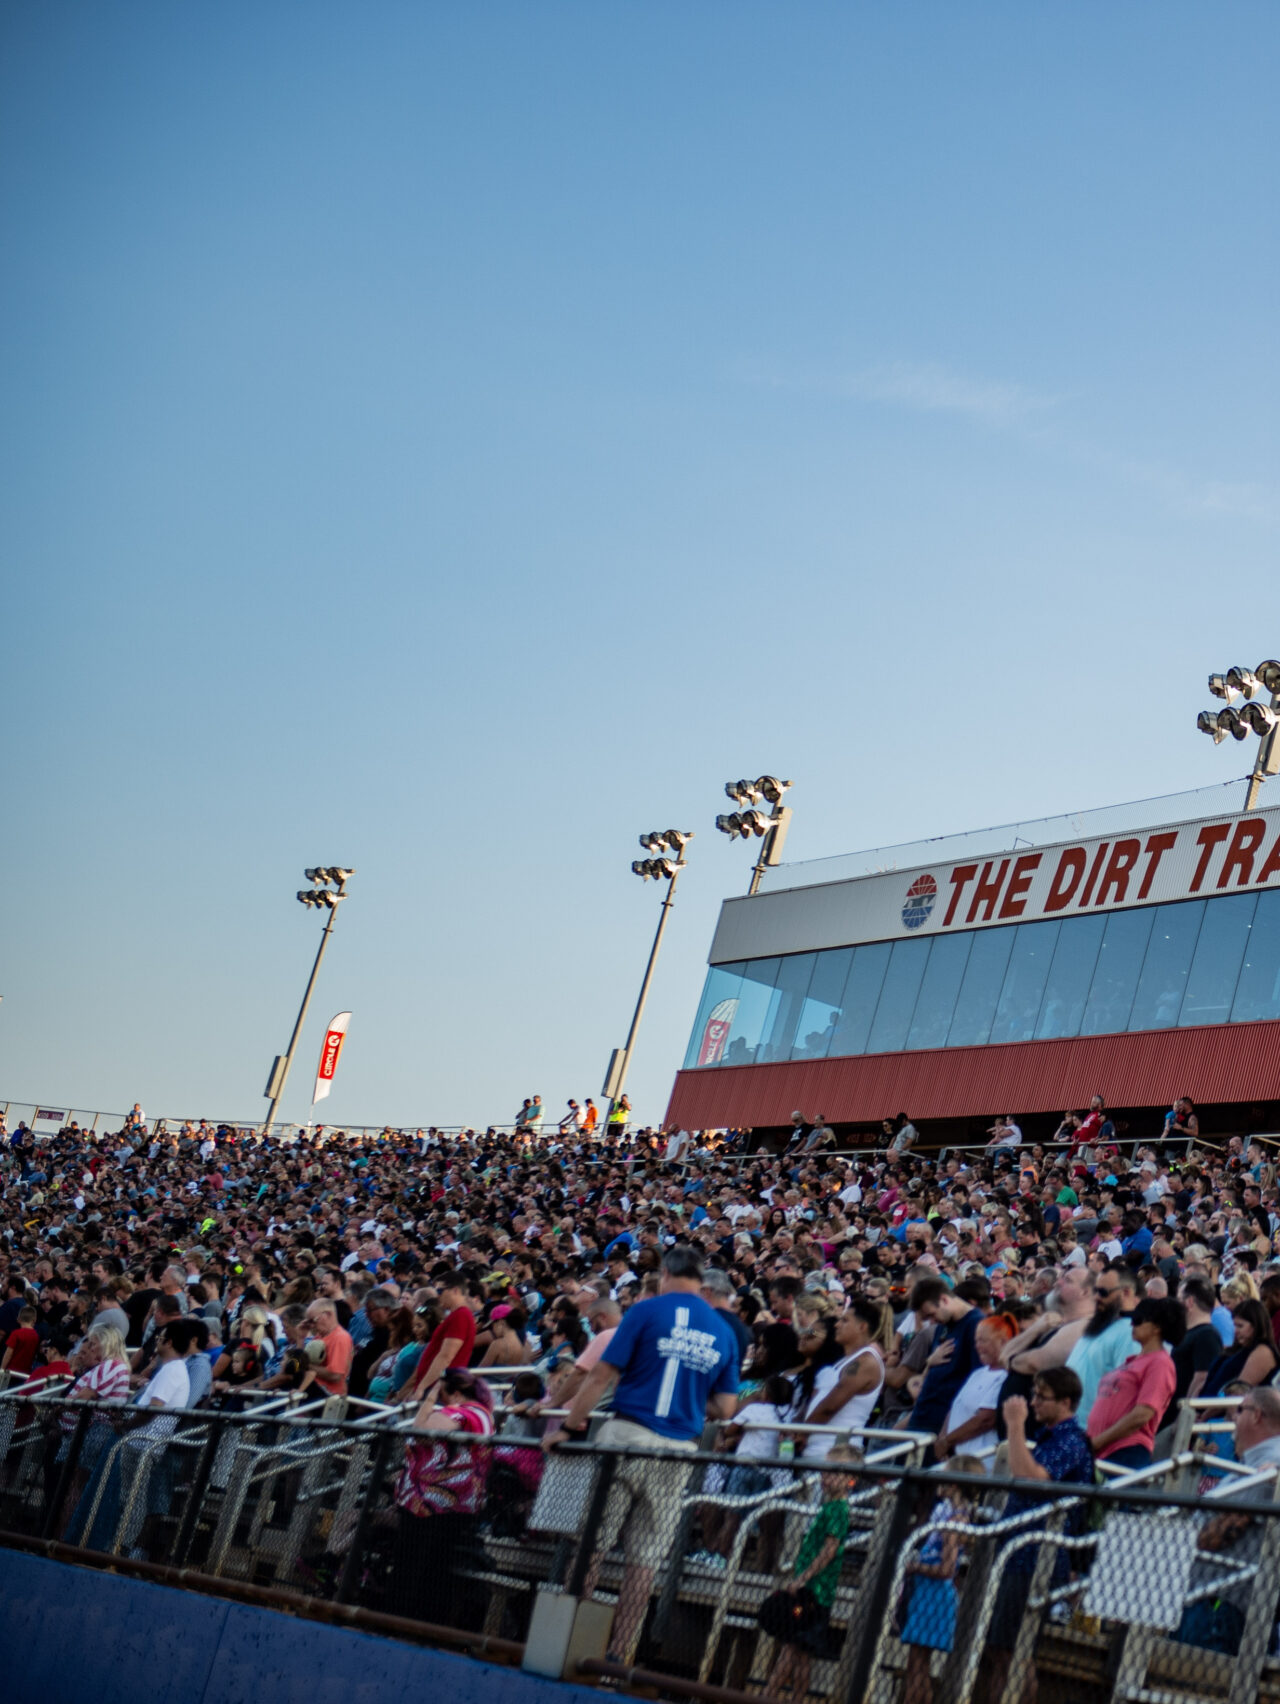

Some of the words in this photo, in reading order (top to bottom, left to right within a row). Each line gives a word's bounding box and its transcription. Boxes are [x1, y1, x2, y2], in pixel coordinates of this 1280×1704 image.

[943, 853, 1042, 927] THE
[1043, 831, 1179, 914] DIRT
[657, 1336, 721, 1365] SERVICES
